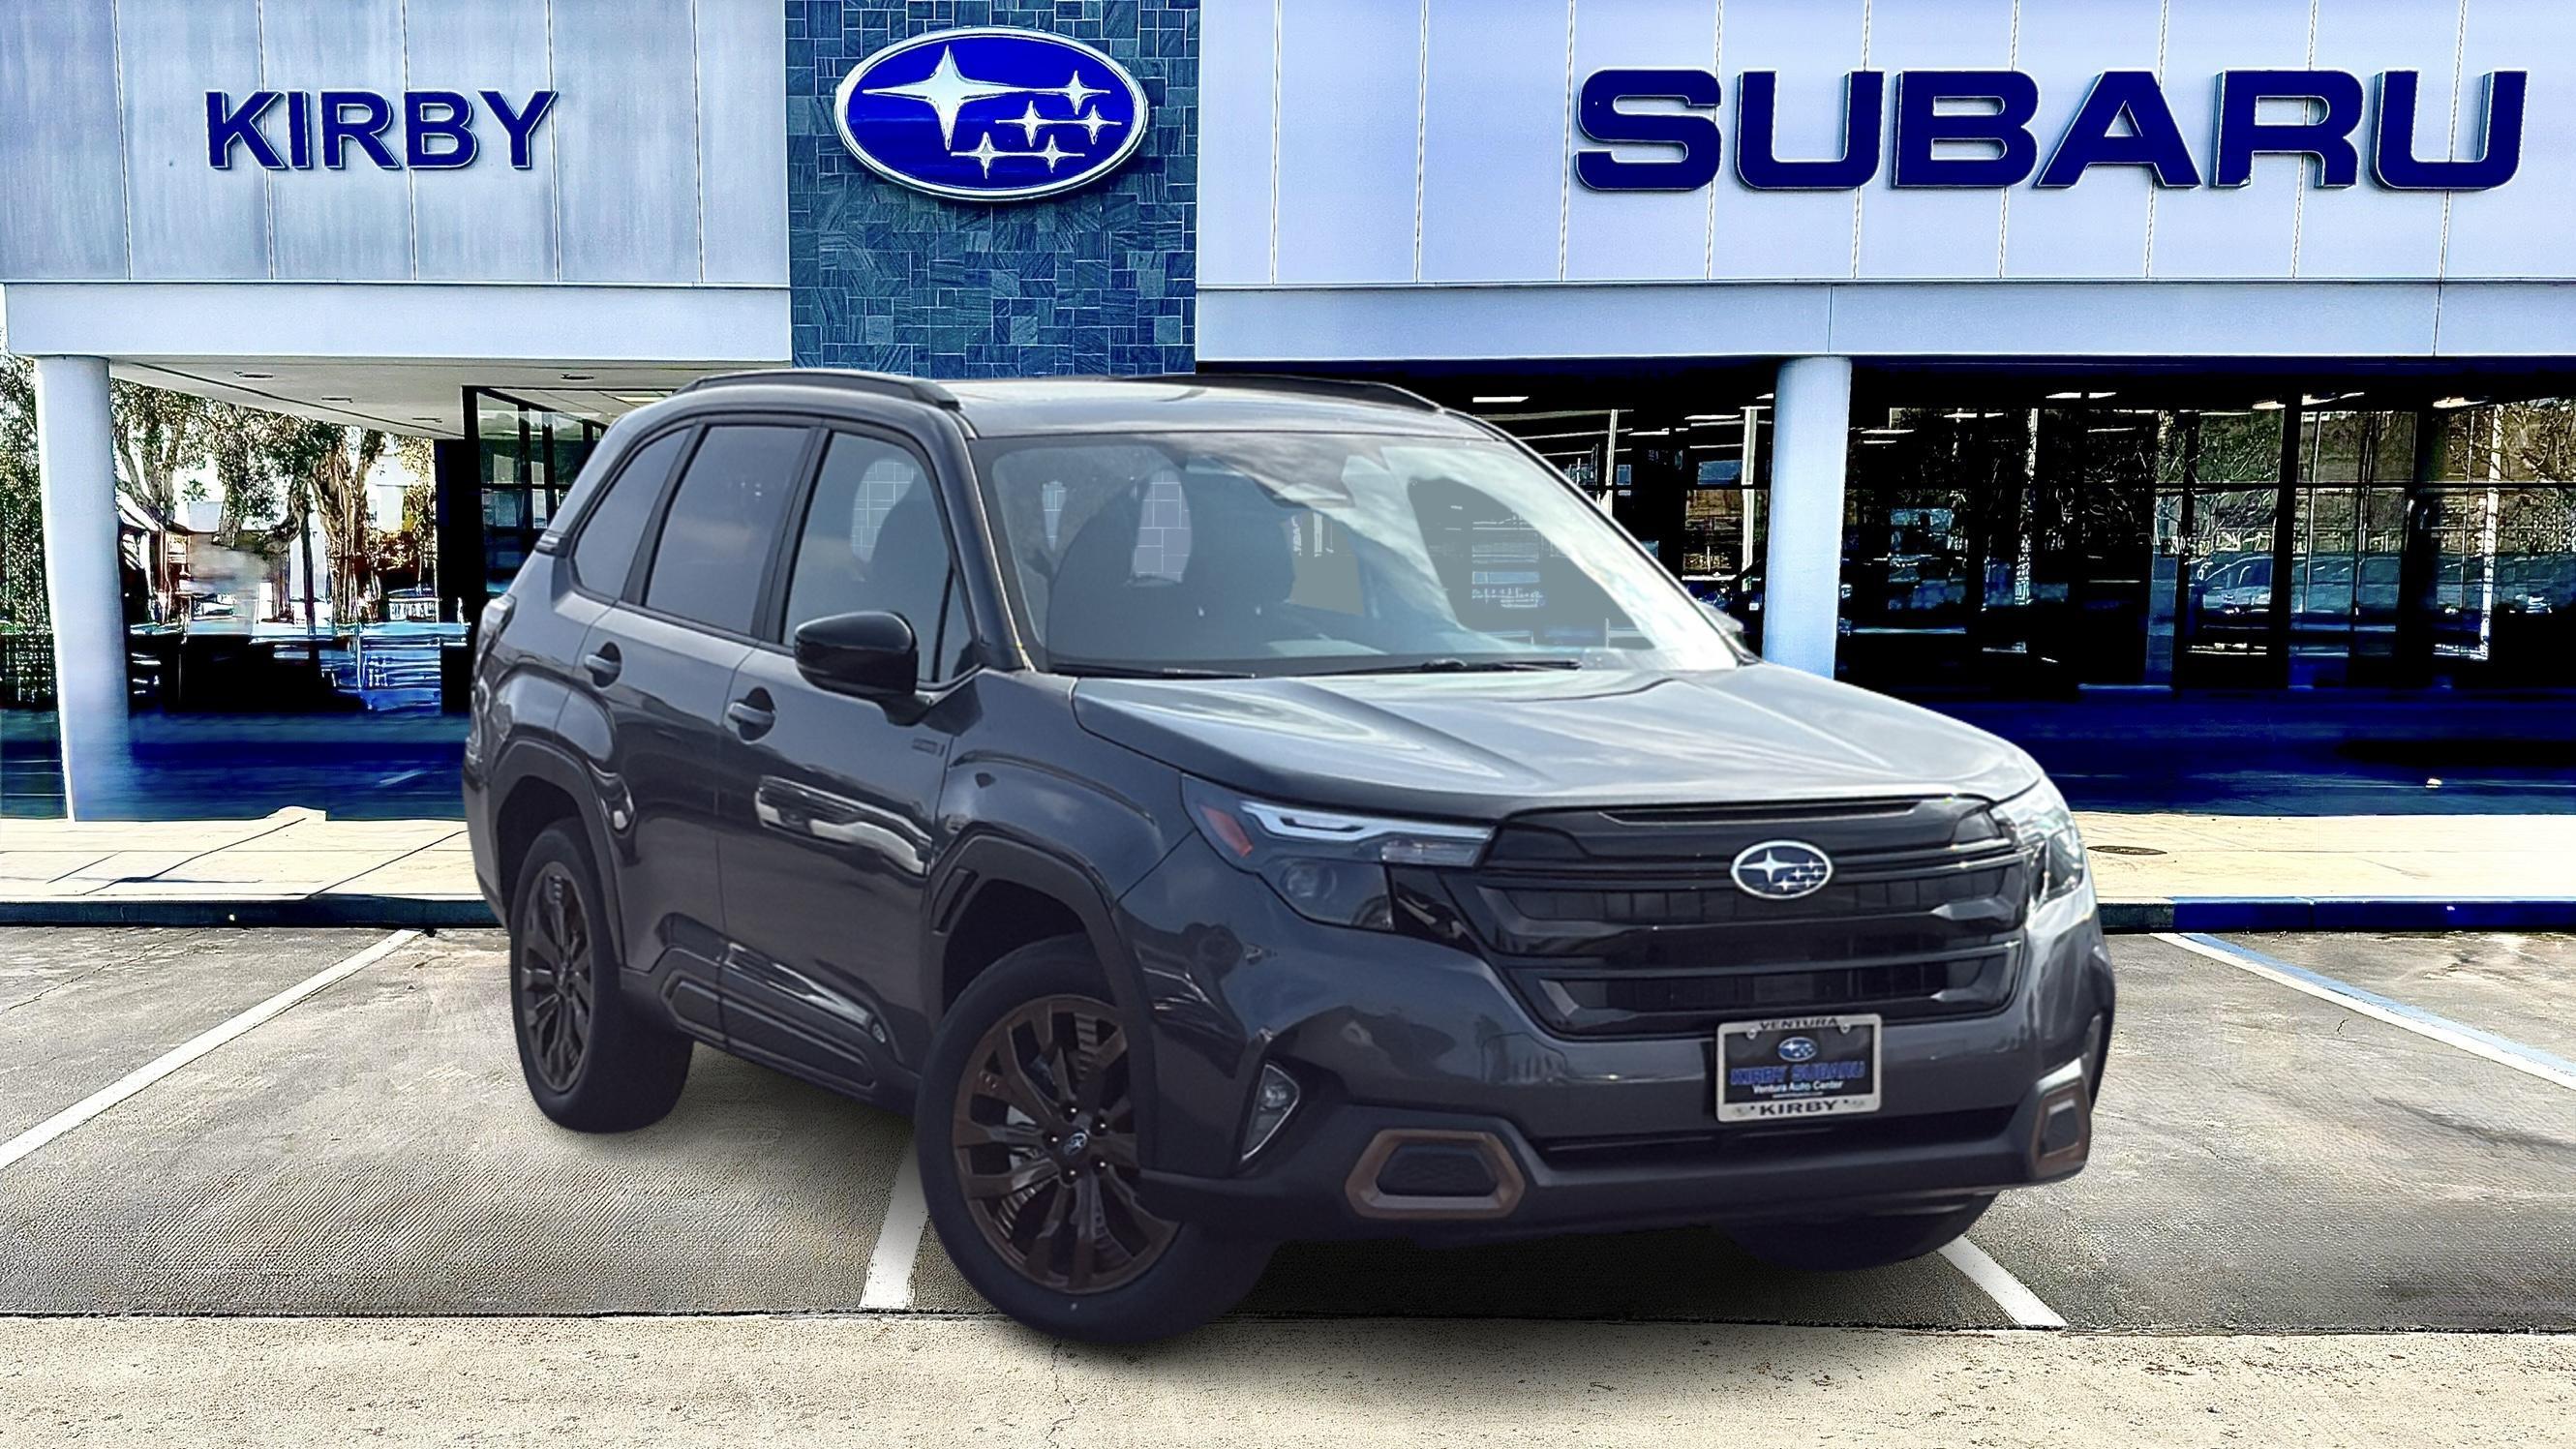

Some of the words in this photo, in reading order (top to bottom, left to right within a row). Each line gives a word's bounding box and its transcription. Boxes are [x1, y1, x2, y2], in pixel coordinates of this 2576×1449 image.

[204, 90, 559, 170] KIRBY
[1575, 69, 2529, 191] SUBARU
[1759, 1017, 1838, 1030] VENTURA
[1731, 1066, 1787, 1085] KIRBY
[1792, 1061, 1864, 1080] SUBARU
[1753, 1083, 1787, 1094] Ventura
[1789, 1082, 1811, 1091] Auto
[1813, 1080, 1843, 1090] Center
[1760, 1100, 1837, 1115] KIRBY
